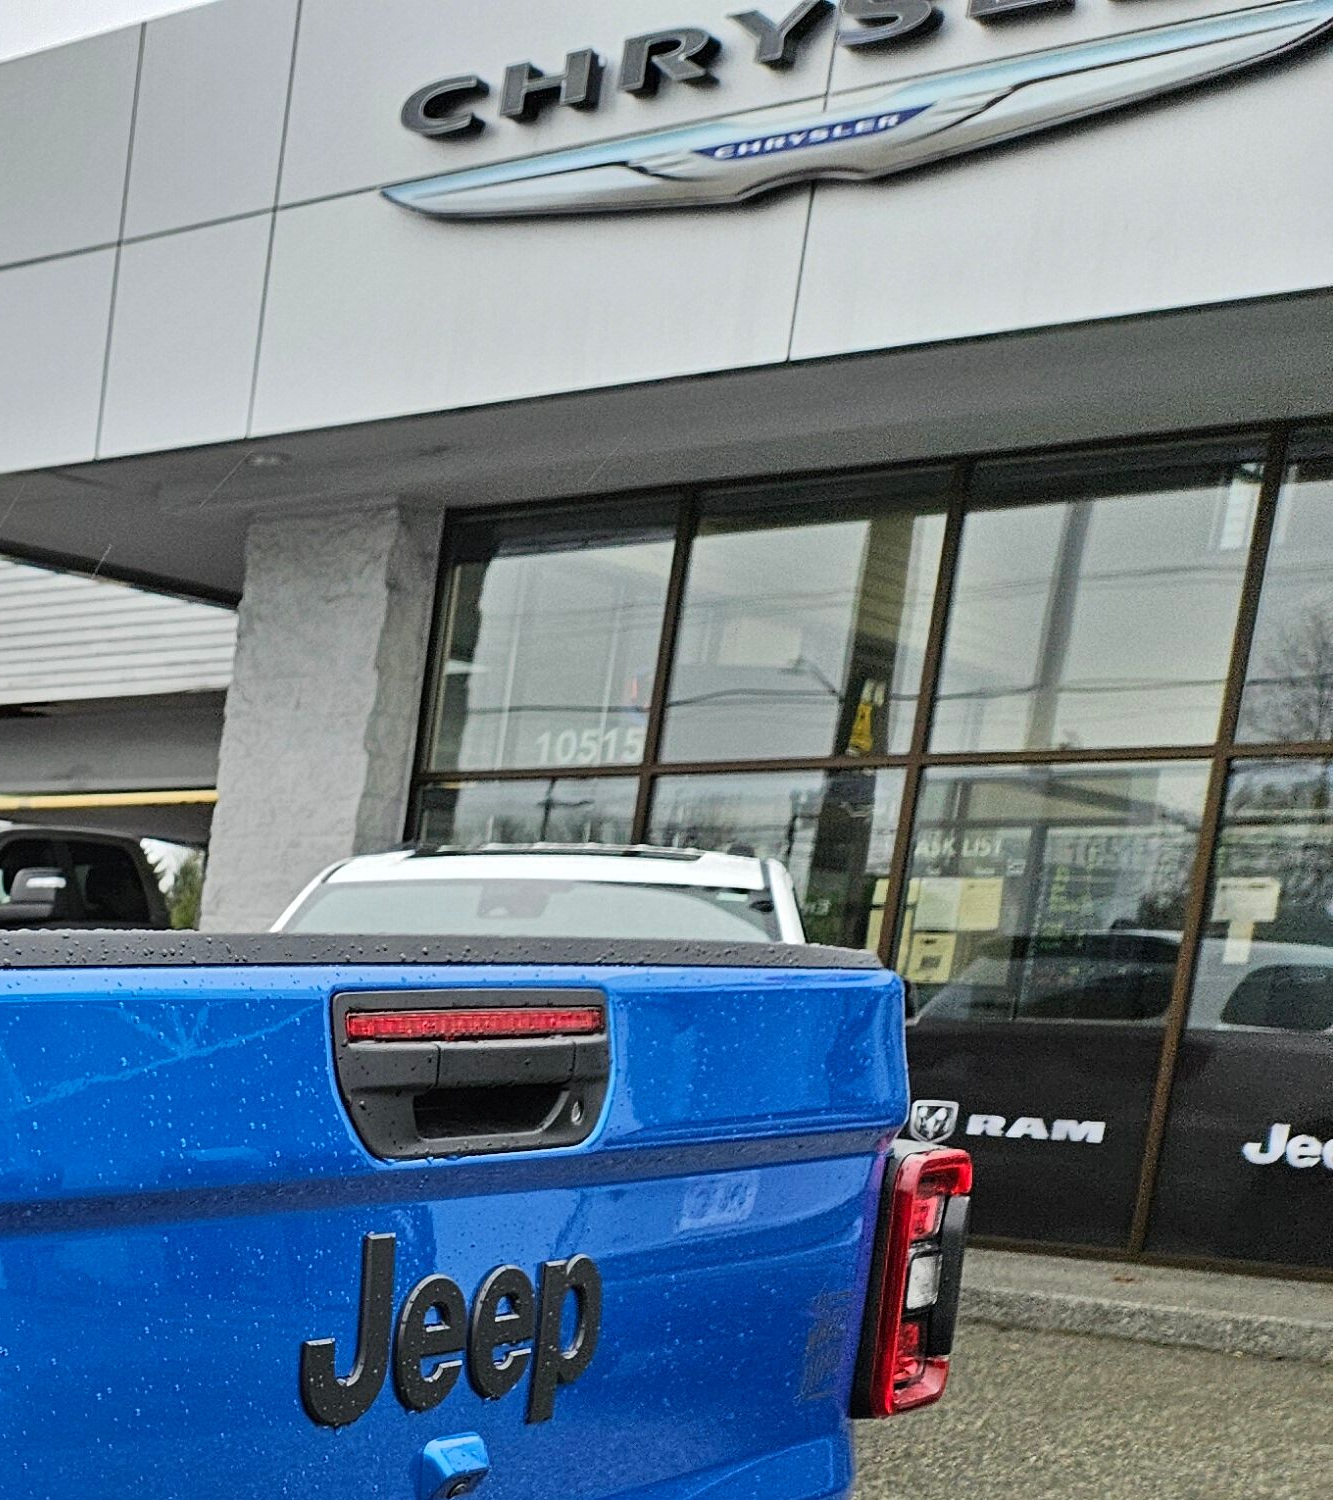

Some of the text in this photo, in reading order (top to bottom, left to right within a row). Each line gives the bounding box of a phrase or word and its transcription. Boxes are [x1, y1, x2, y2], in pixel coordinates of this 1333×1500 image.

[714, 114, 900, 160] CHRYSLER
[534, 726, 644, 766] 10515
[966, 1114, 1106, 1143] RAM
[1242, 1123, 1333, 1169] Je
[299, 1231, 602, 1427] Jeep
